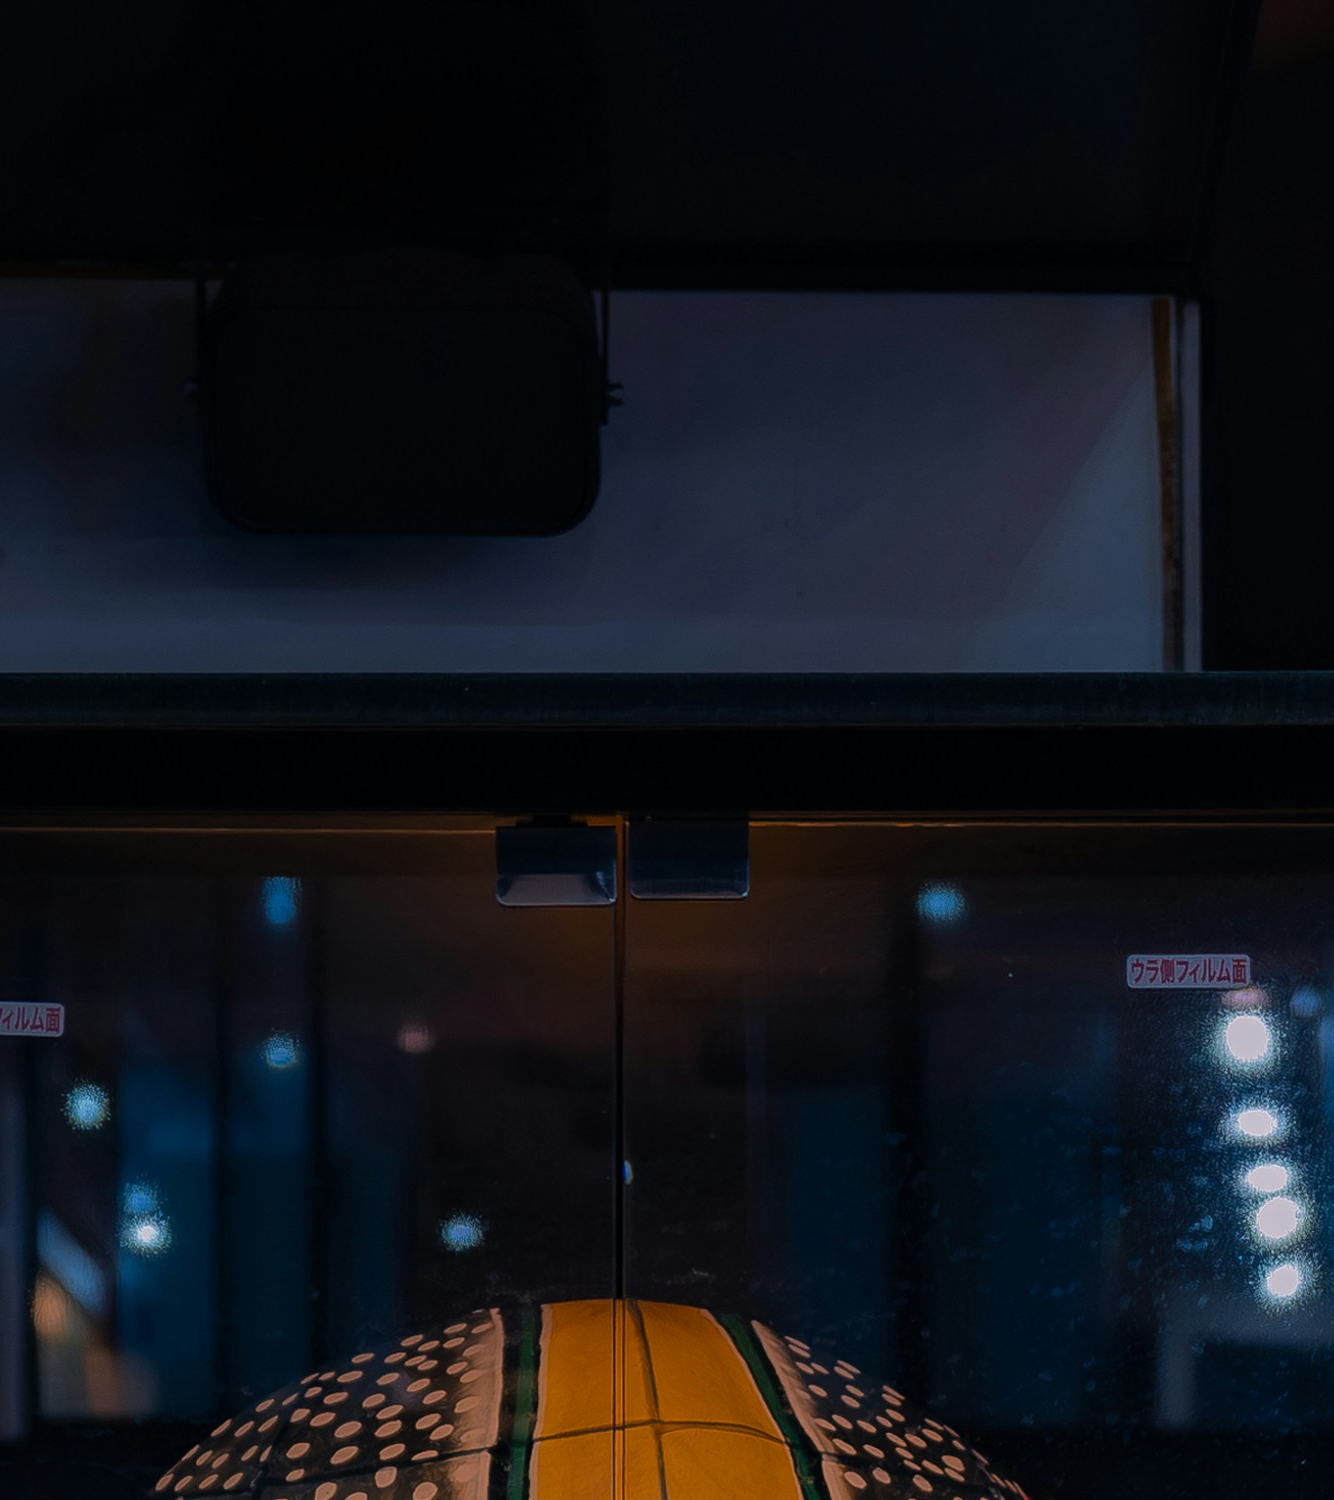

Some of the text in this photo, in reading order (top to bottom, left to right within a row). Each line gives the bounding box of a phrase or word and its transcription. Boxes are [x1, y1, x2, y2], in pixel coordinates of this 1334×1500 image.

[1131, 958, 1247, 984] ウラ側フィルム面
